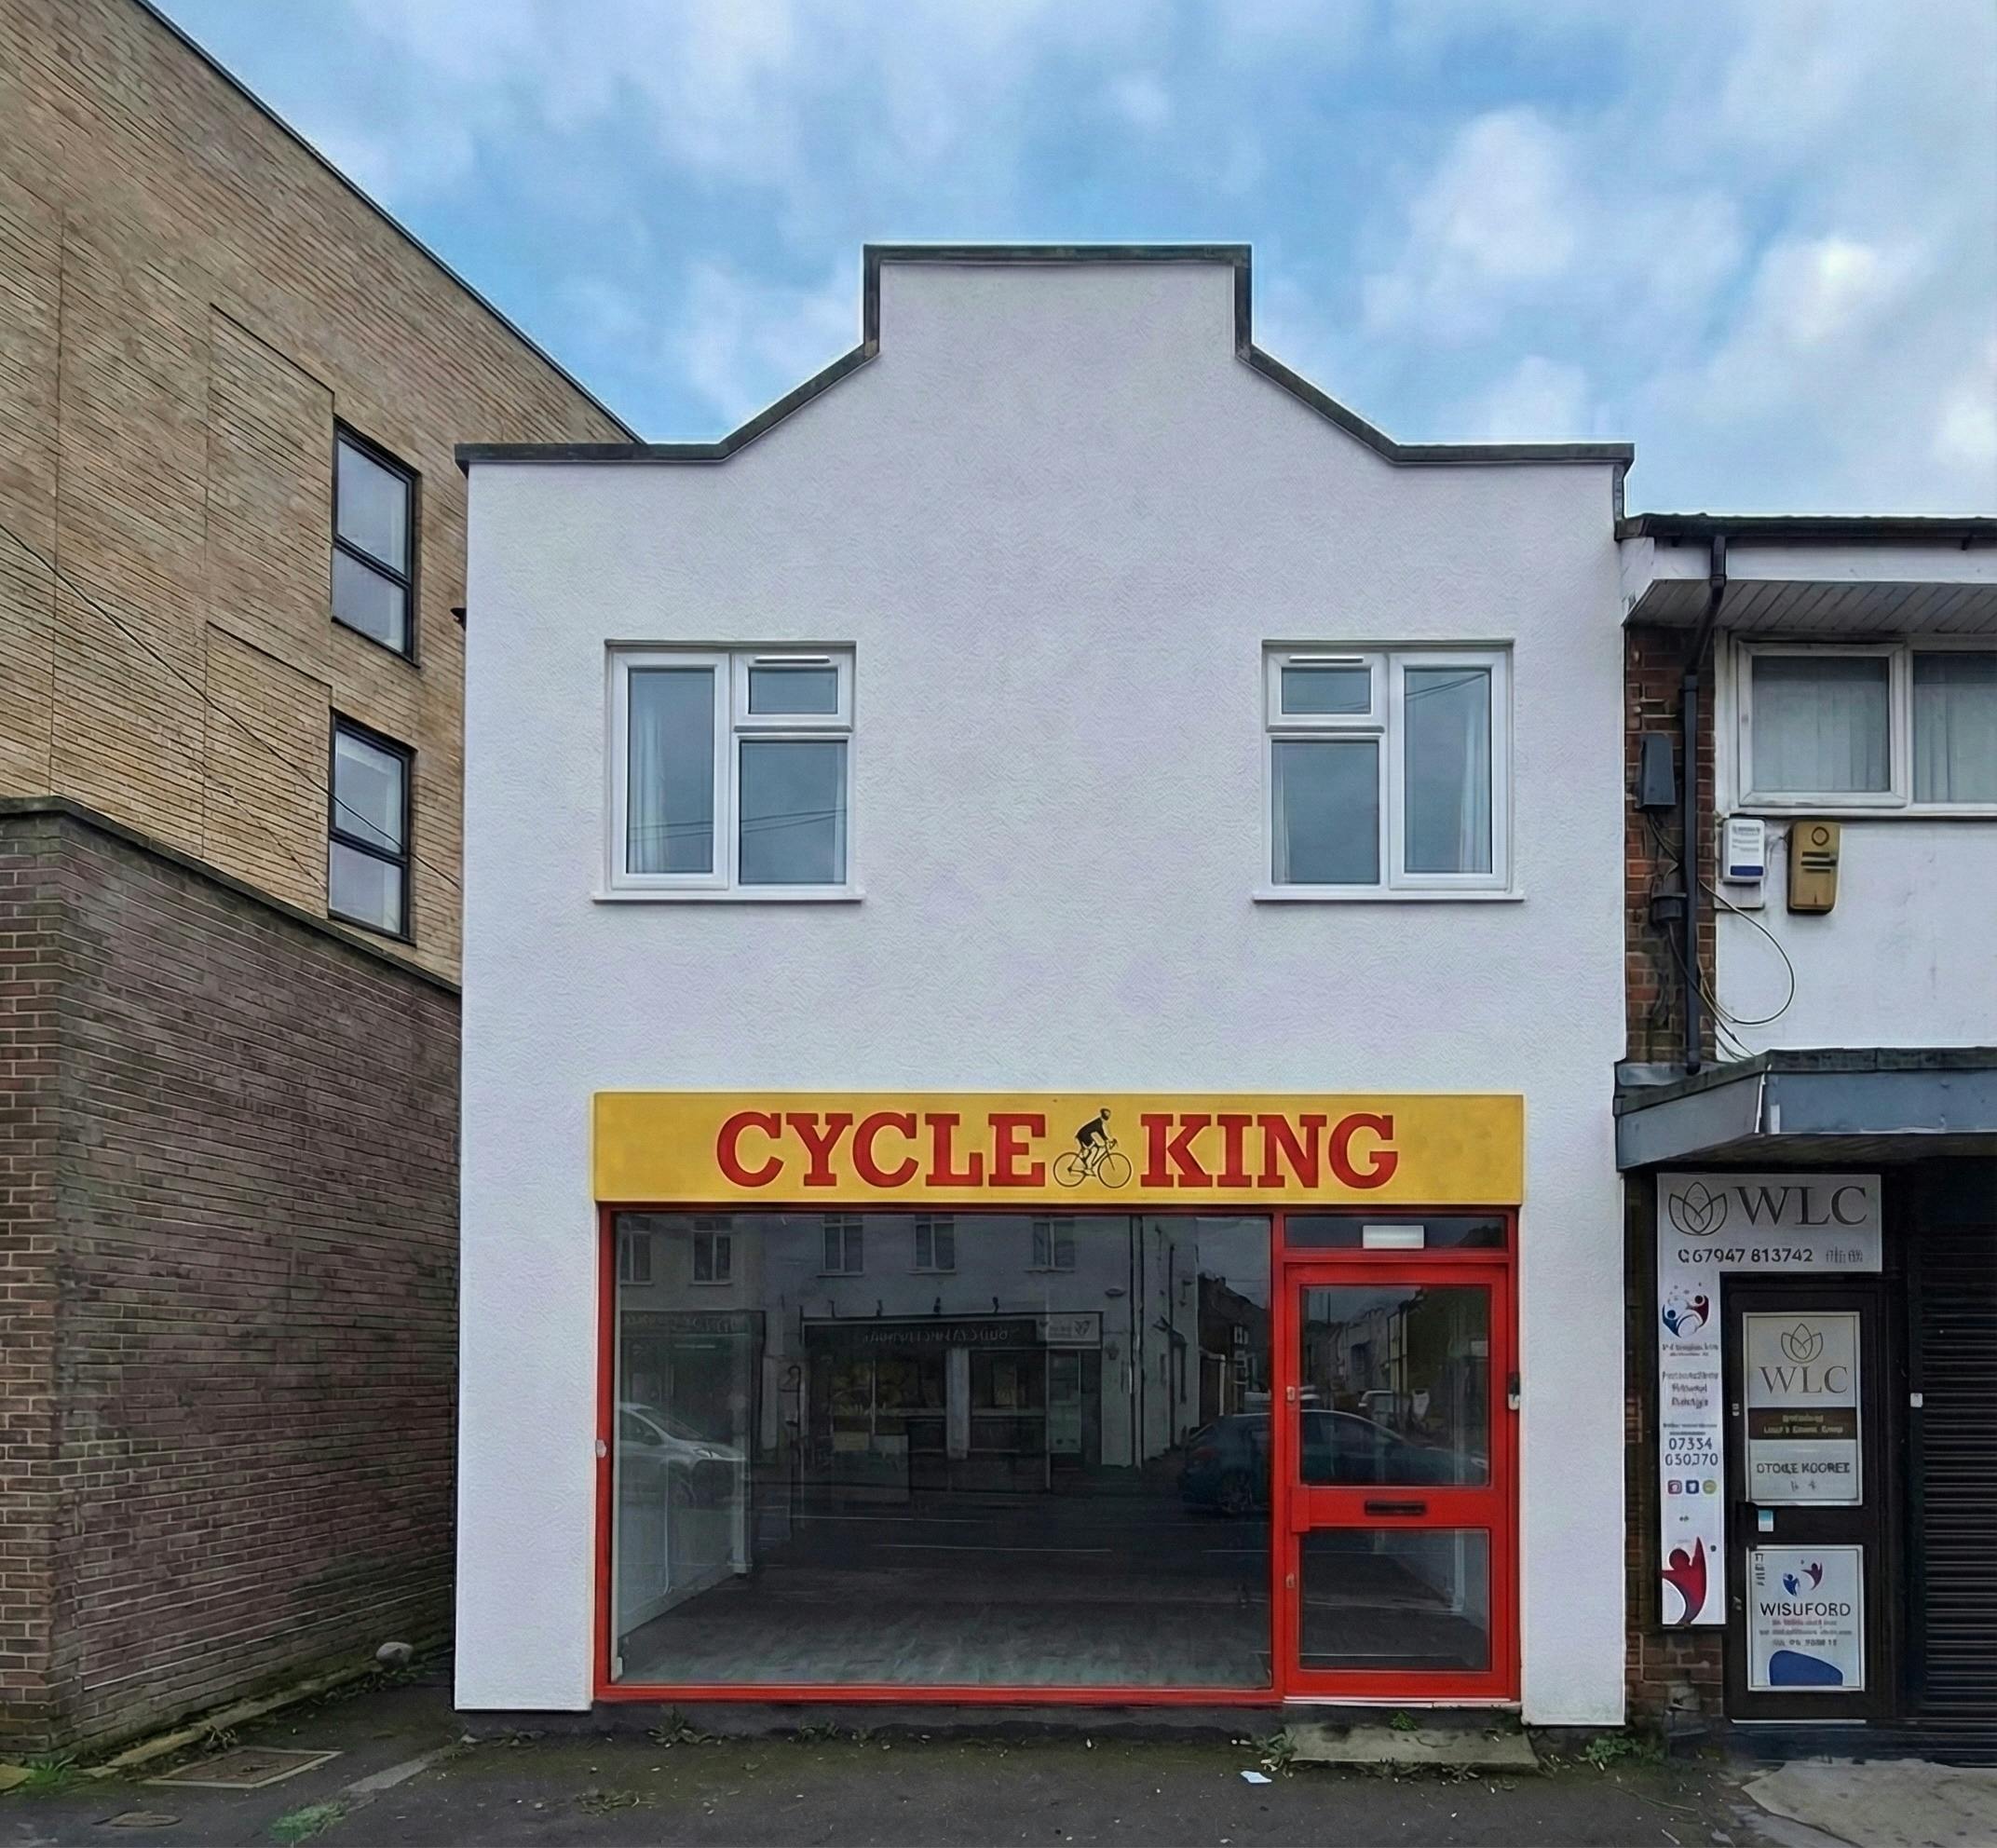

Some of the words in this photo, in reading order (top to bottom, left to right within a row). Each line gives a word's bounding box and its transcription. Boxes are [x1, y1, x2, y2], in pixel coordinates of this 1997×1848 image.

[717, 1111, 1046, 1189] CYCLE
[1138, 1112, 1400, 1189] KING
[1733, 1185, 1868, 1227] WLC
[1751, 1248, 1814, 1263] 813742
[1759, 1365, 1849, 1394] WLC
